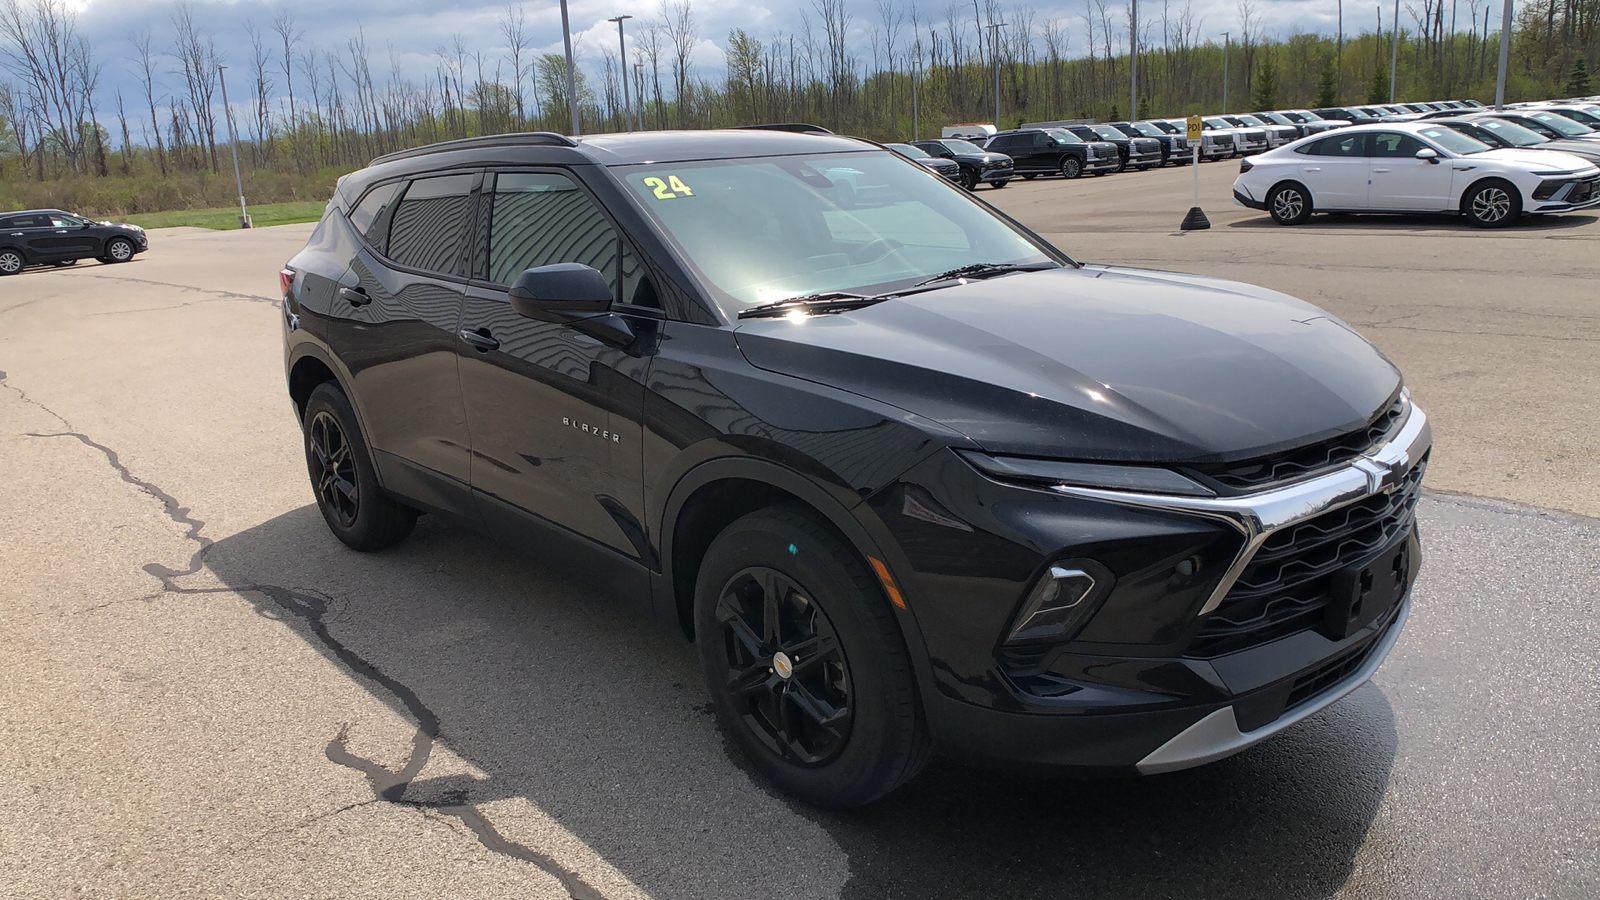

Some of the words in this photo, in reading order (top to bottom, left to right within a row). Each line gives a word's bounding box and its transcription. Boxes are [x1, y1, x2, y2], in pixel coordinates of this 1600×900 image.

[1187, 123, 1200, 132] PDI
[643, 175, 694, 200] 24
[562, 417, 621, 444] BLAZER
